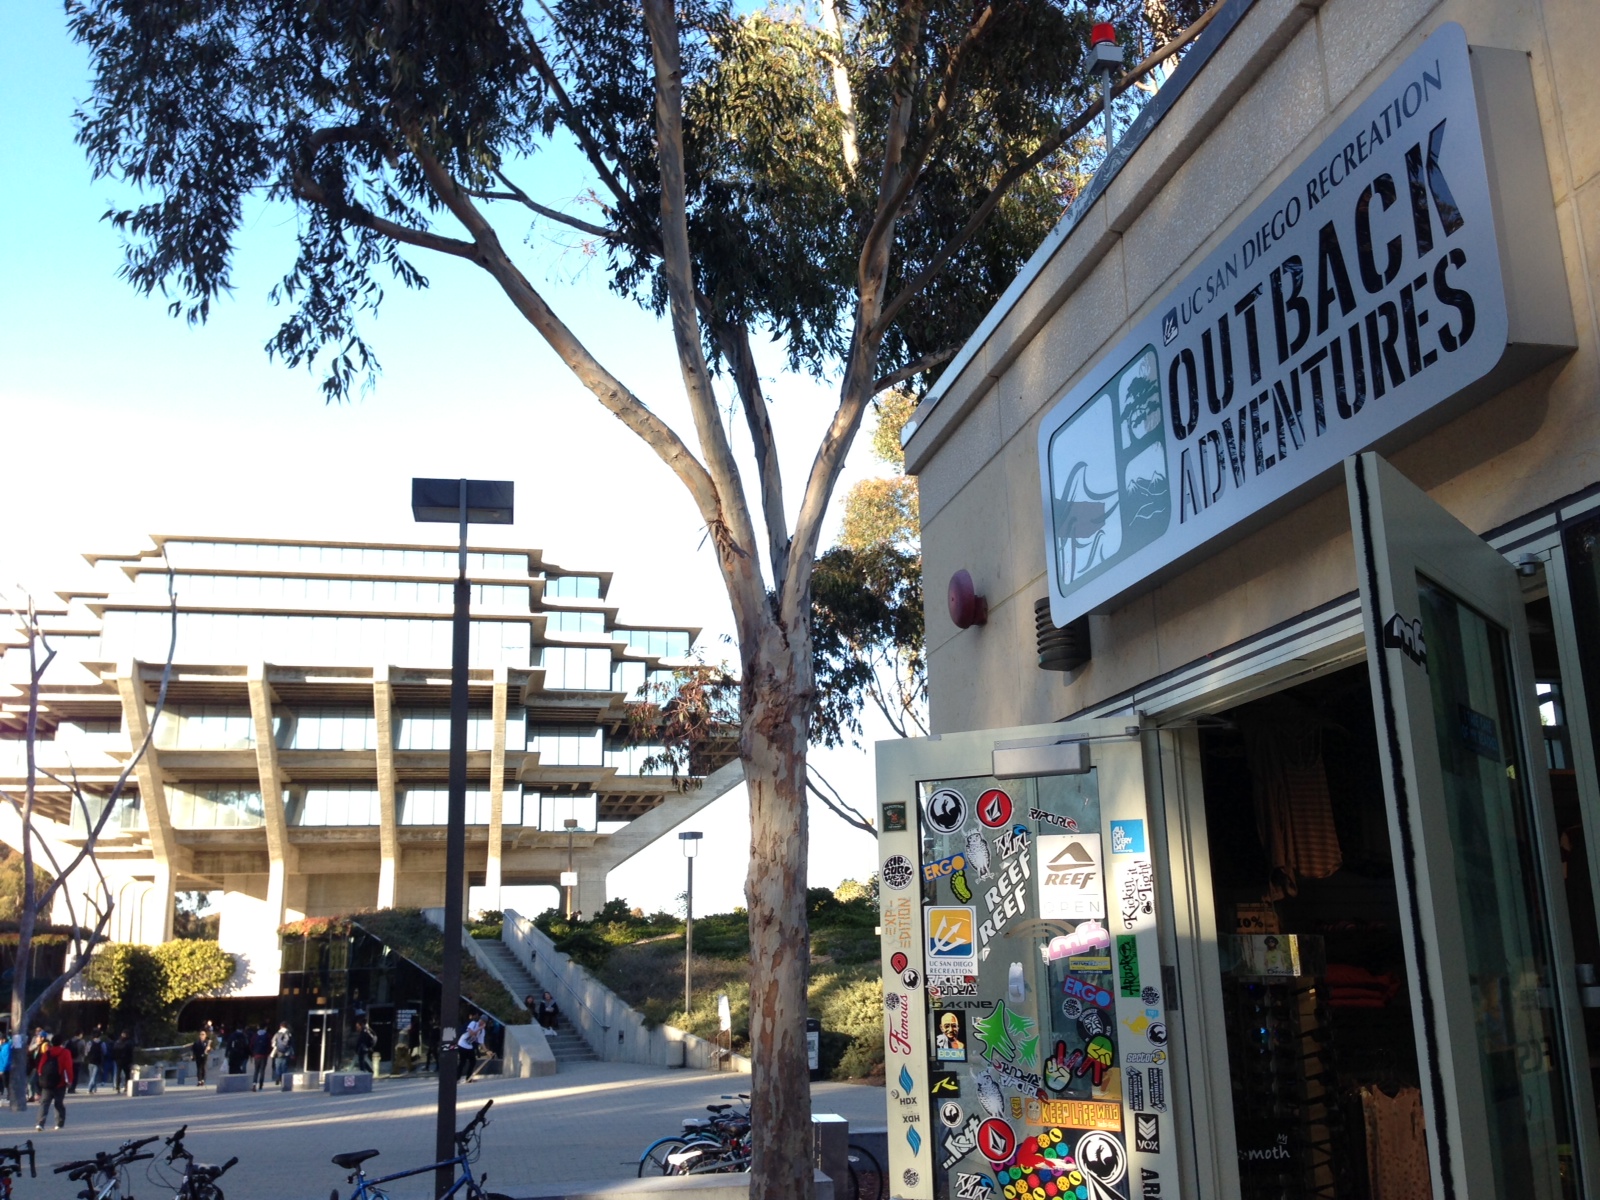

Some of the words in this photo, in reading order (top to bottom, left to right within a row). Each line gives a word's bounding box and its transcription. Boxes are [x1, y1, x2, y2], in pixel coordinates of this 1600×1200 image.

[1181, 286, 1204, 325] UC
[1206, 254, 1239, 304] SAN
[1242, 196, 1301, 270] DIEGO
[1306, 59, 1443, 210] RECREATION
[1168, 117, 1465, 440] OUTBACK
[1180, 248, 1476, 524] ADVENTURES
[923, 856, 965, 881] ERGO
[984, 847, 1031, 913] REEF
[1044, 872, 1096, 890] REEF
[979, 881, 1026, 946] REEF
[1063, 977, 1111, 1007] ERGO
[889, 993, 912, 1056] Famous
[900, 1097, 917, 1106] HDX
[1041, 1103, 1070, 1124] KEEP
[1137, 1140, 1158, 1150] VOX
